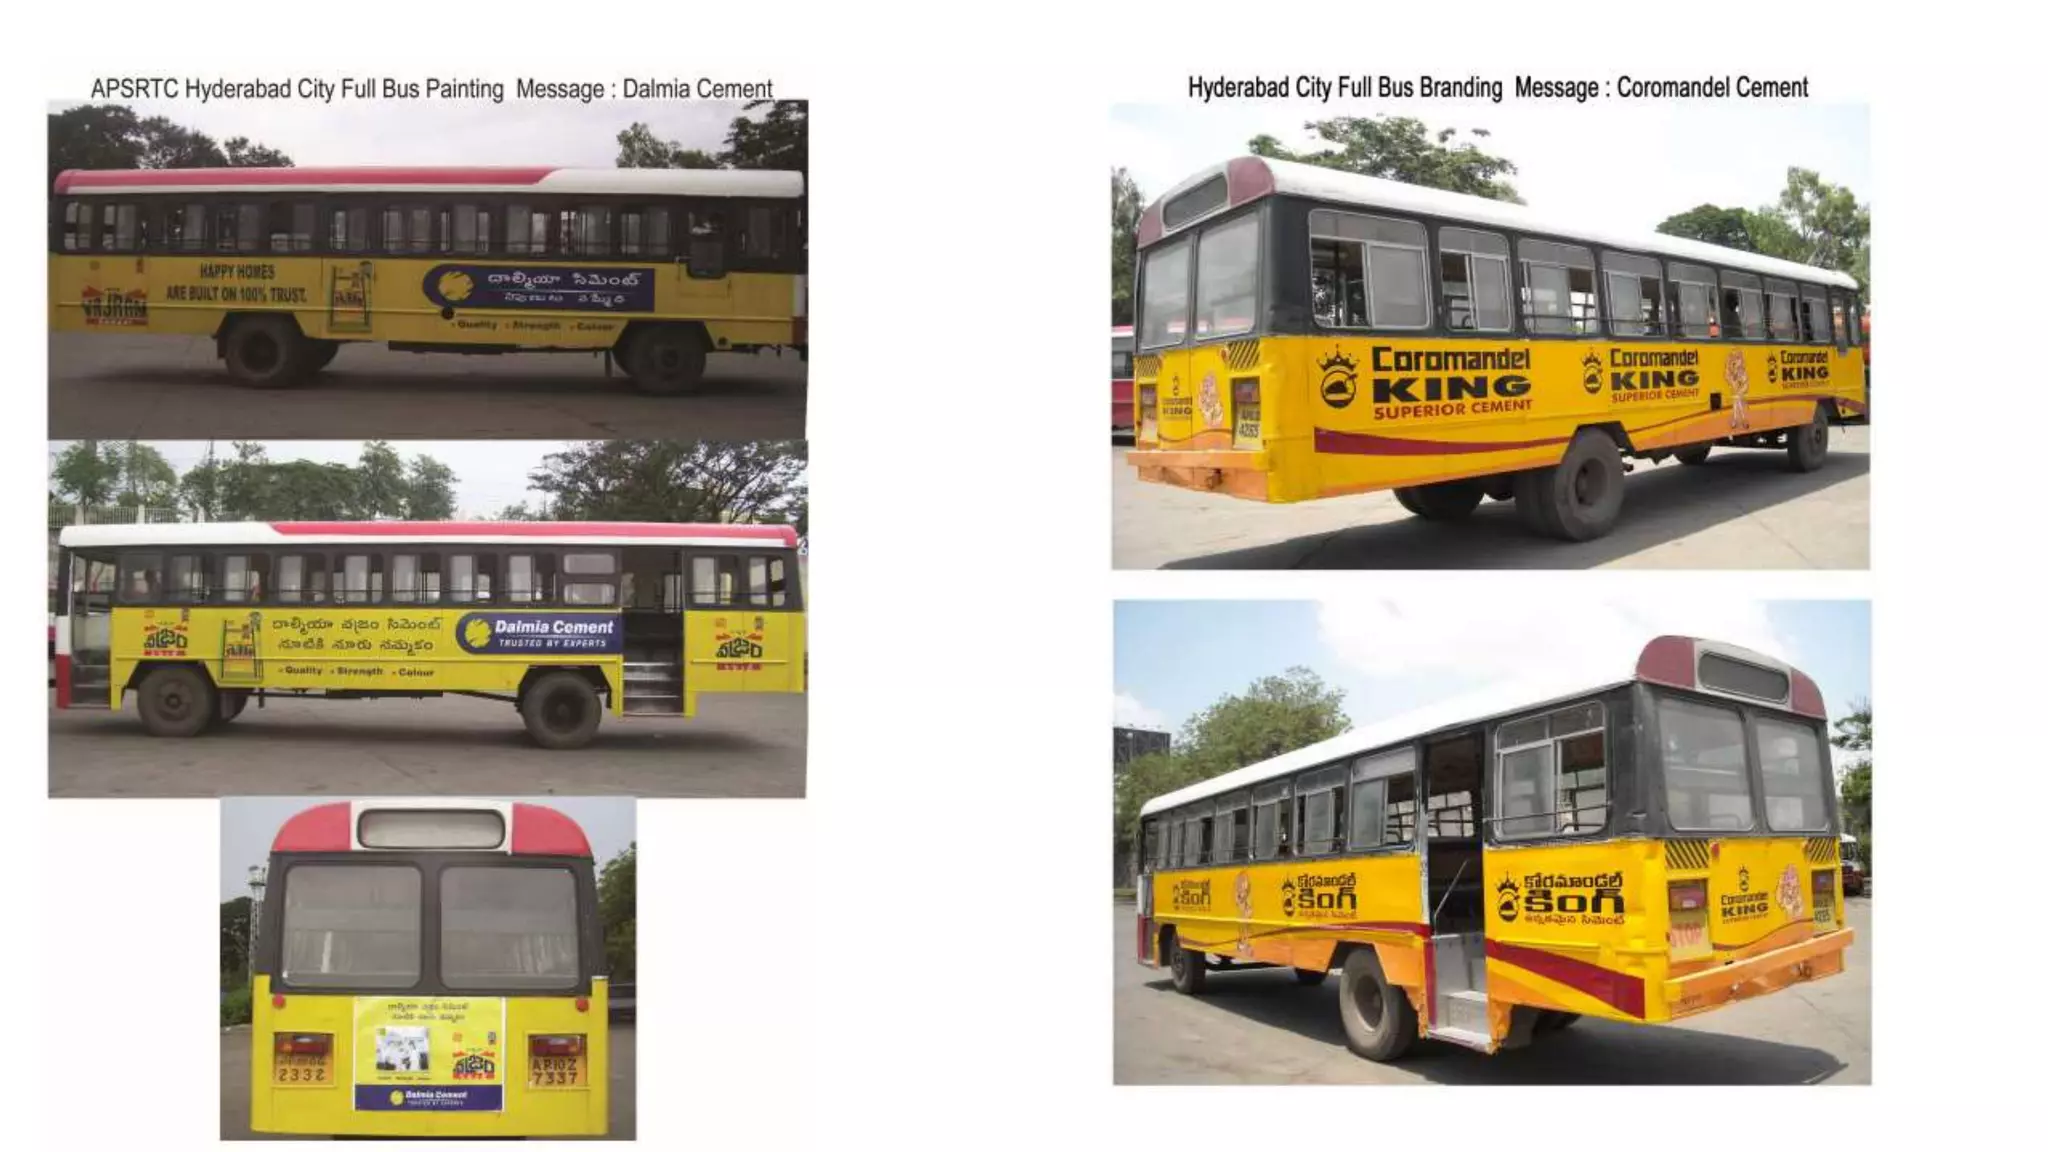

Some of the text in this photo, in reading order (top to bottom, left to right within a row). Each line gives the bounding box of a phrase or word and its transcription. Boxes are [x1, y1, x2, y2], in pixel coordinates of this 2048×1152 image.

[200, 263, 275, 280] HAPPY HOMES
[167, 286, 186, 301] ARE
[189, 285, 218, 302] BUILT
[222, 286, 237, 302] ON
[240, 286, 267, 303] 100%
[457, 321, 497, 331] Quality
[1372, 346, 1531, 371] Coromandel
[1610, 348, 1698, 367] Coromandel
[1611, 370, 1700, 391] KING
[1782, 367, 1829, 381] KING
[1372, 375, 1532, 403] KING
[1612, 388, 1700, 403] SUPERIOR CEMENT
[1373, 399, 1533, 420] SUPERIOR CEMENT
[496, 620, 614, 634] Dalmia Cement
[500, 639, 606, 648] TRUSTED BY EXPERTS
[285, 666, 435, 677] Quality Strength Colour
[1524, 888, 1625, 913] కింగ్
[1721, 902, 1769, 918] KING
[279, 1068, 325, 1081] 2332
[533, 1072, 577, 1084] 7337
